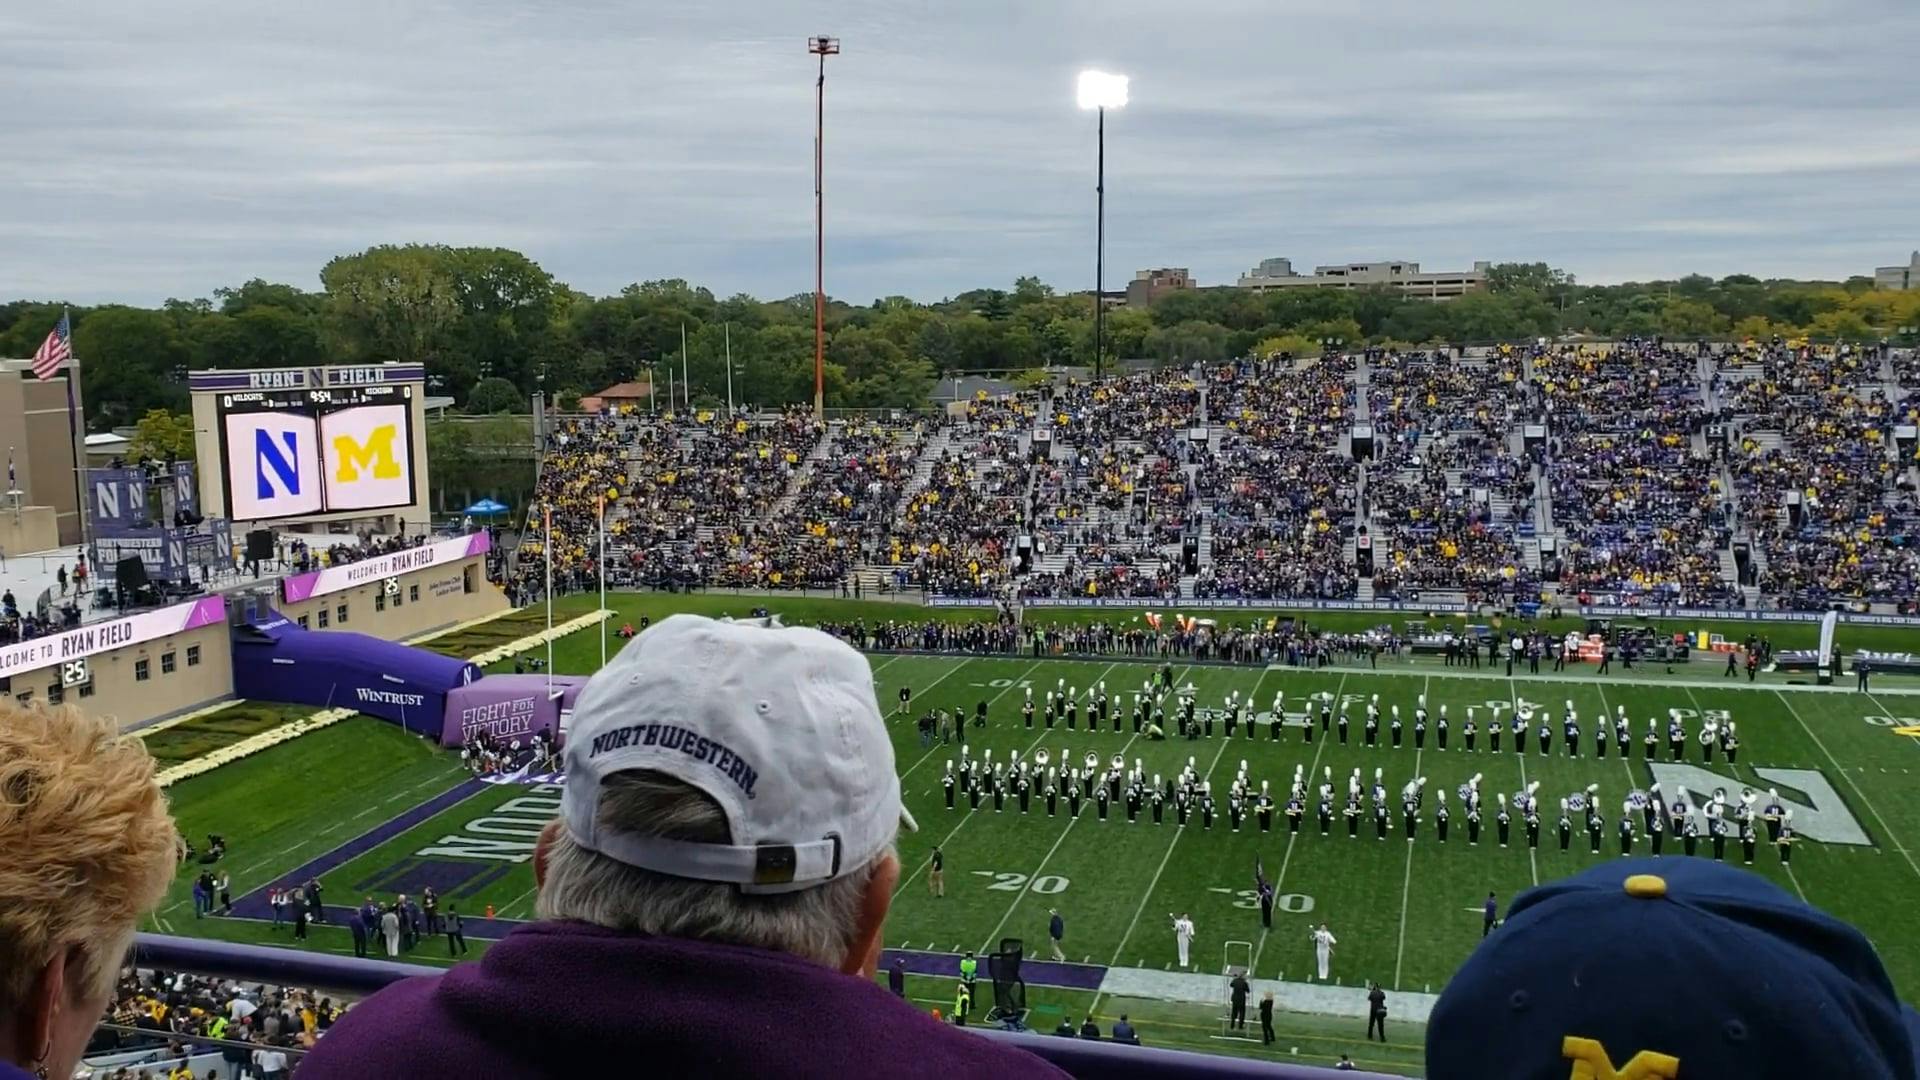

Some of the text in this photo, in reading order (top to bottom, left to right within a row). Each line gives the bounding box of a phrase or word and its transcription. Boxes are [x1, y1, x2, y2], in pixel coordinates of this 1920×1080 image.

[249, 368, 385, 388] RYAN N FIELD
[224, 394, 233, 408] 0
[404, 386, 411, 398] 0
[256, 428, 300, 500] N
[333, 424, 401, 483] M
[96, 482, 120, 518] N
[129, 483, 143, 509] N
[178, 475, 191, 501] N
[169, 541, 183, 568] N
[216, 532, 229, 558] N
[348, 548, 434, 580] WELCOME TO RYAN FIELD
[386, 577, 398, 593] 25
[42, 644, 53, 658] TO
[62, 631, 94, 657] RYAN
[100, 622, 132, 647] FIELD
[65, 661, 85, 683] 25
[462, 701, 534, 726] FIGHT FOR
[589, 724, 759, 799] NORTHWESTERN
[1647, 761, 1874, 847] N
[986, 872, 1071, 895] 20
[1232, 889, 1316, 913] 30
